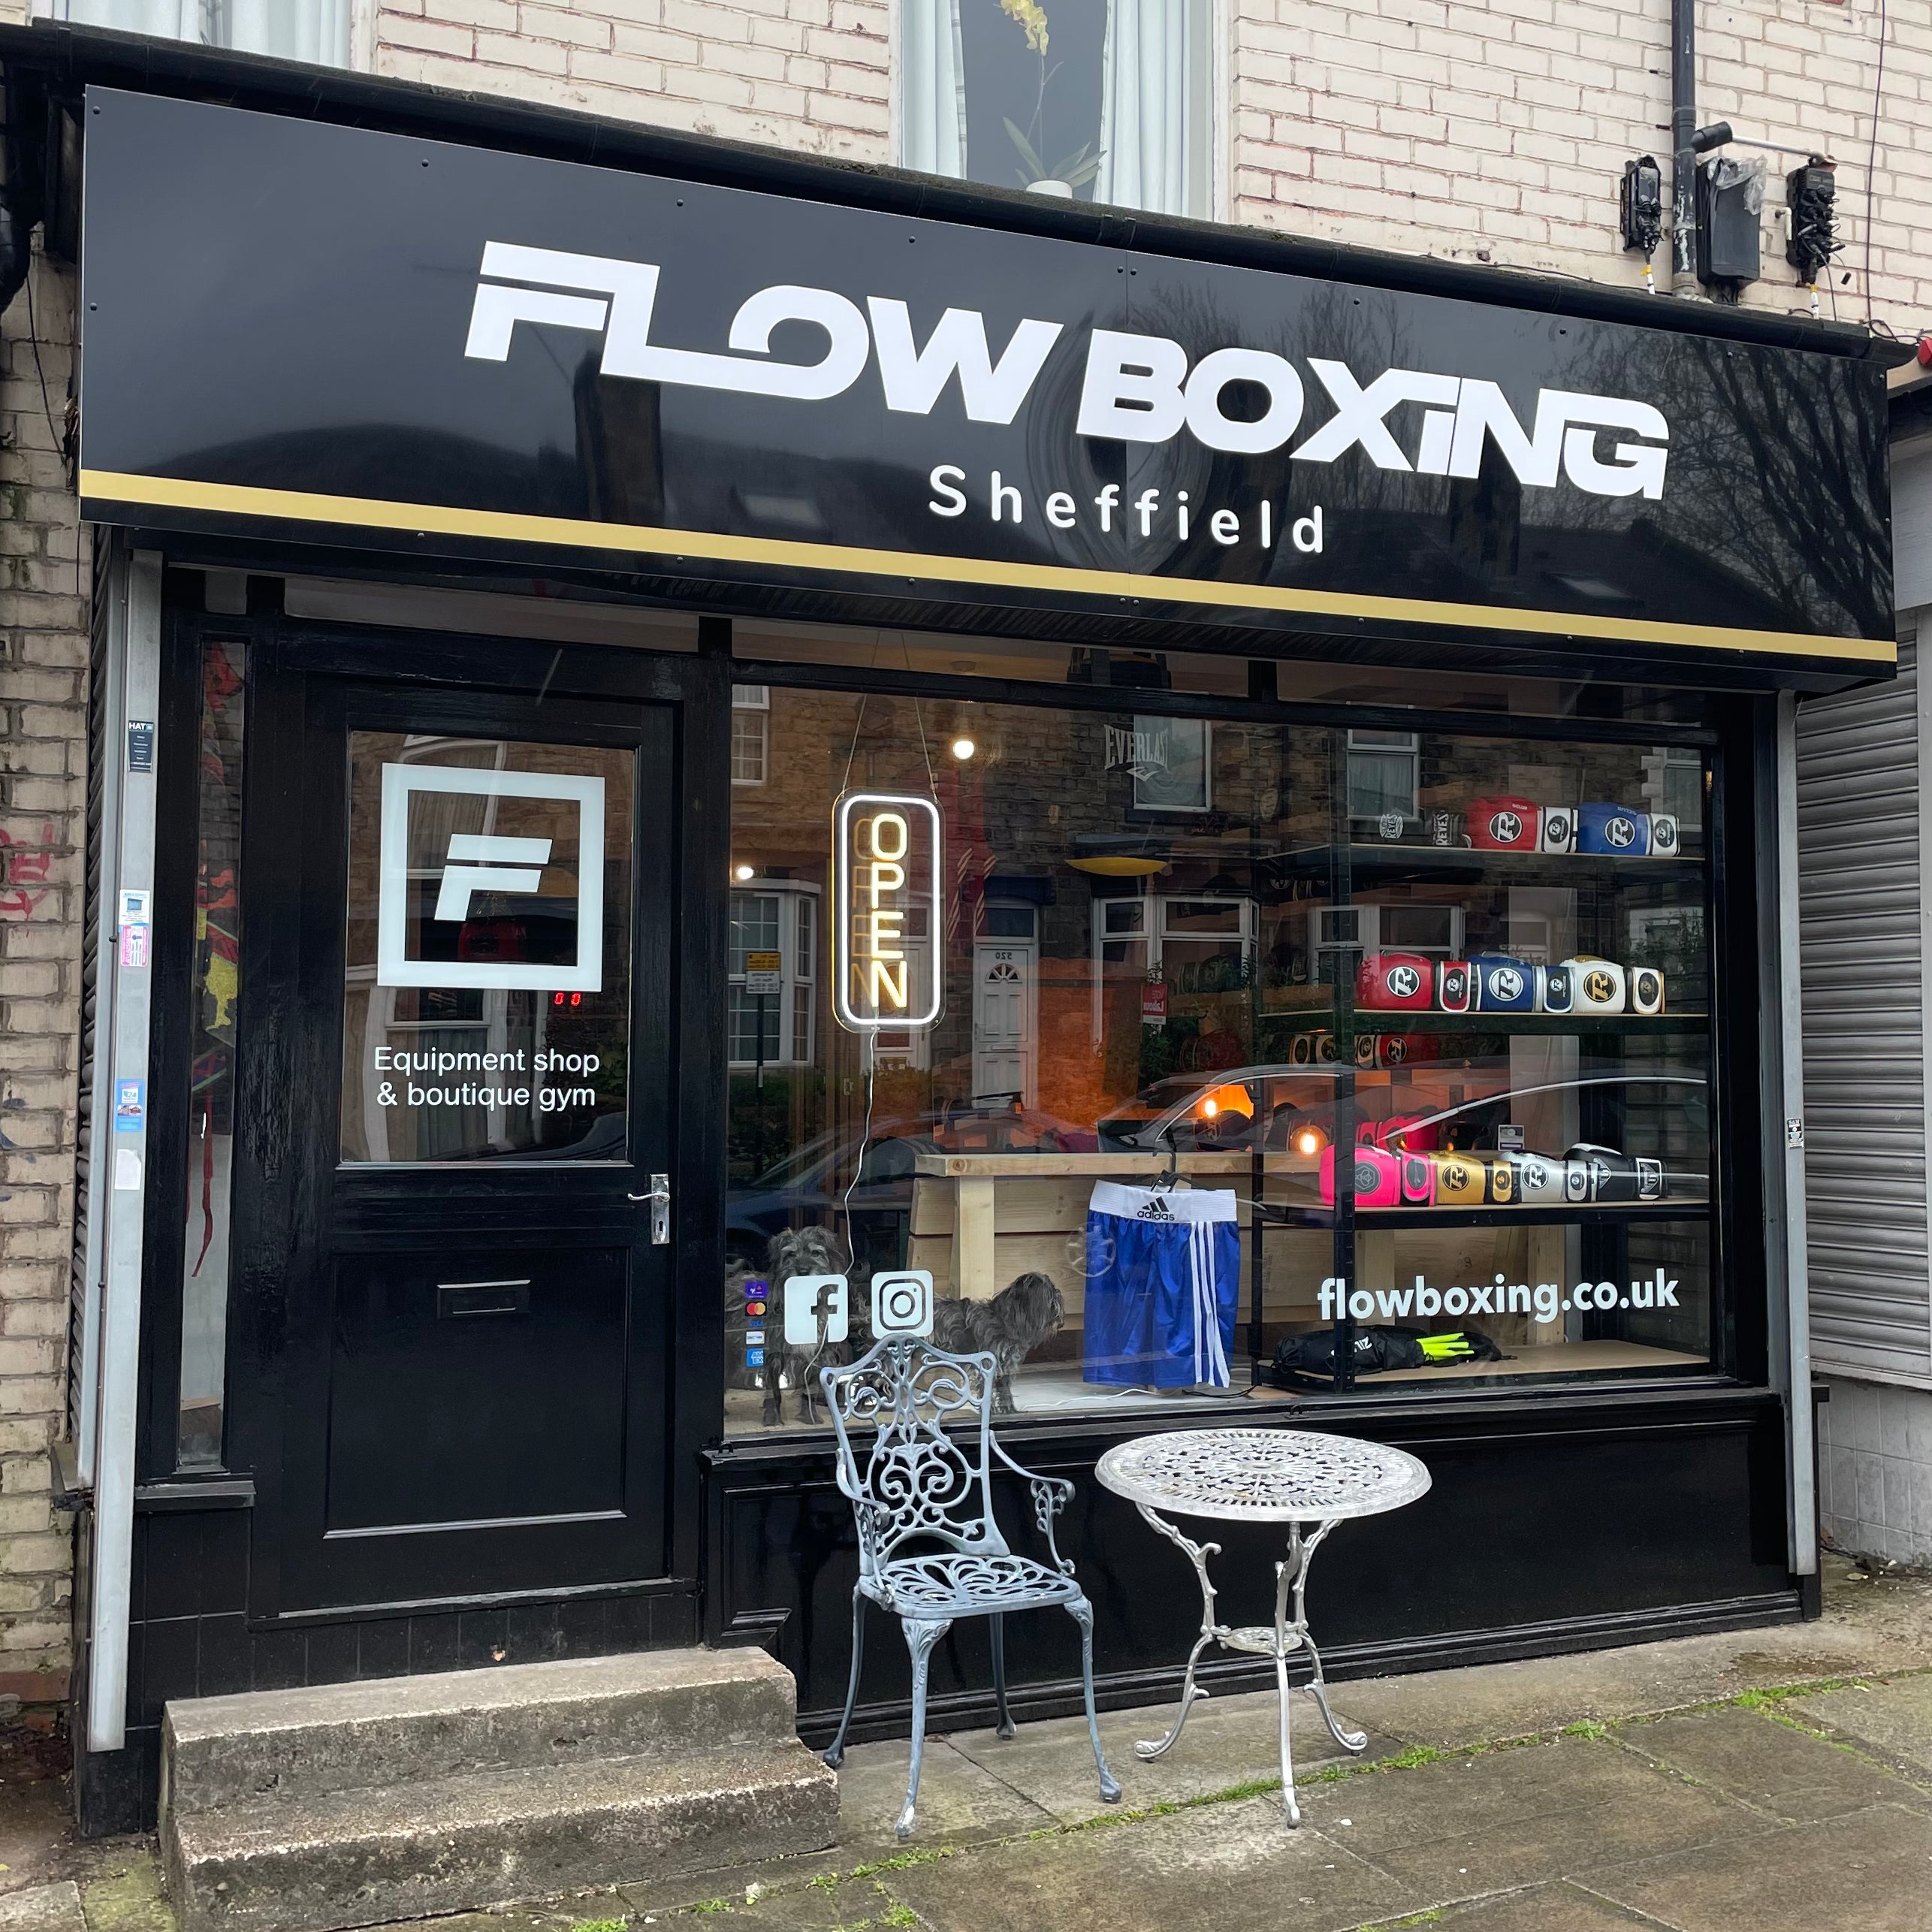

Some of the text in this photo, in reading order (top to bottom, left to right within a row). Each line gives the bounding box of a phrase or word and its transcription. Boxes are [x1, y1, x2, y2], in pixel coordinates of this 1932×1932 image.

[464, 240, 1670, 500] FLOW BOXING
[928, 464, 1324, 554] Sheffield
[1103, 723, 1171, 774] EVERLAST
[1435, 813, 1450, 847] REYES
[871, 814, 907, 1007] OPEN
[374, 1046, 601, 1078] Equipment shop
[376, 1081, 596, 1112] & boutique gym
[1137, 1209, 1176, 1221] adidas
[1316, 1267, 1681, 1323] flowboxing.co.uk
